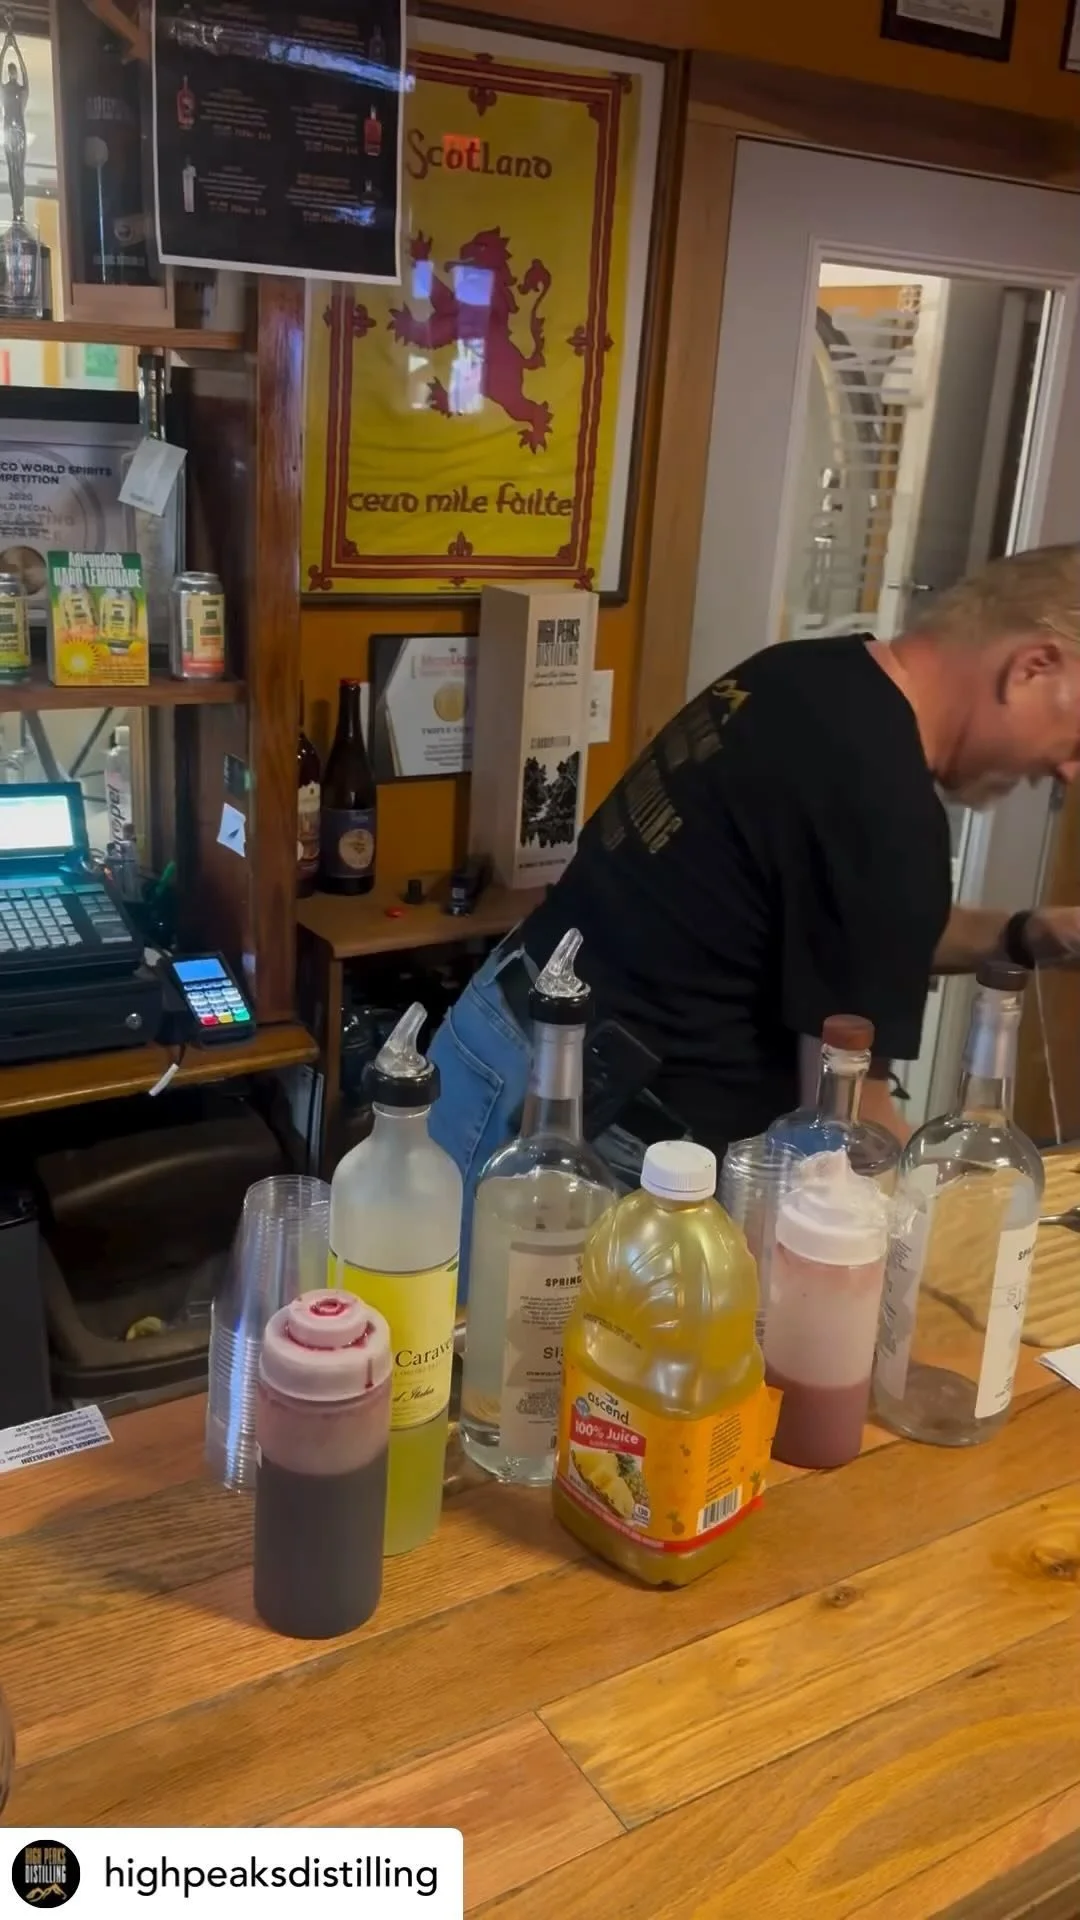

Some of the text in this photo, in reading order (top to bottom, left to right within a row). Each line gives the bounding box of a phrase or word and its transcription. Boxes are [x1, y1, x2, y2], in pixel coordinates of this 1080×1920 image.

[0, 462, 112, 476] CO WORLD SPIRITS
[85, 568, 142, 589] LEMONADE
[557, 618, 580, 642] PEAKS
[535, 642, 579, 668] DISTILLING
[545, 1276, 582, 1288] SPRING
[588, 1391, 630, 1425] ascend
[575, 1420, 605, 1439] 100%
[606, 1427, 640, 1445] Juice
